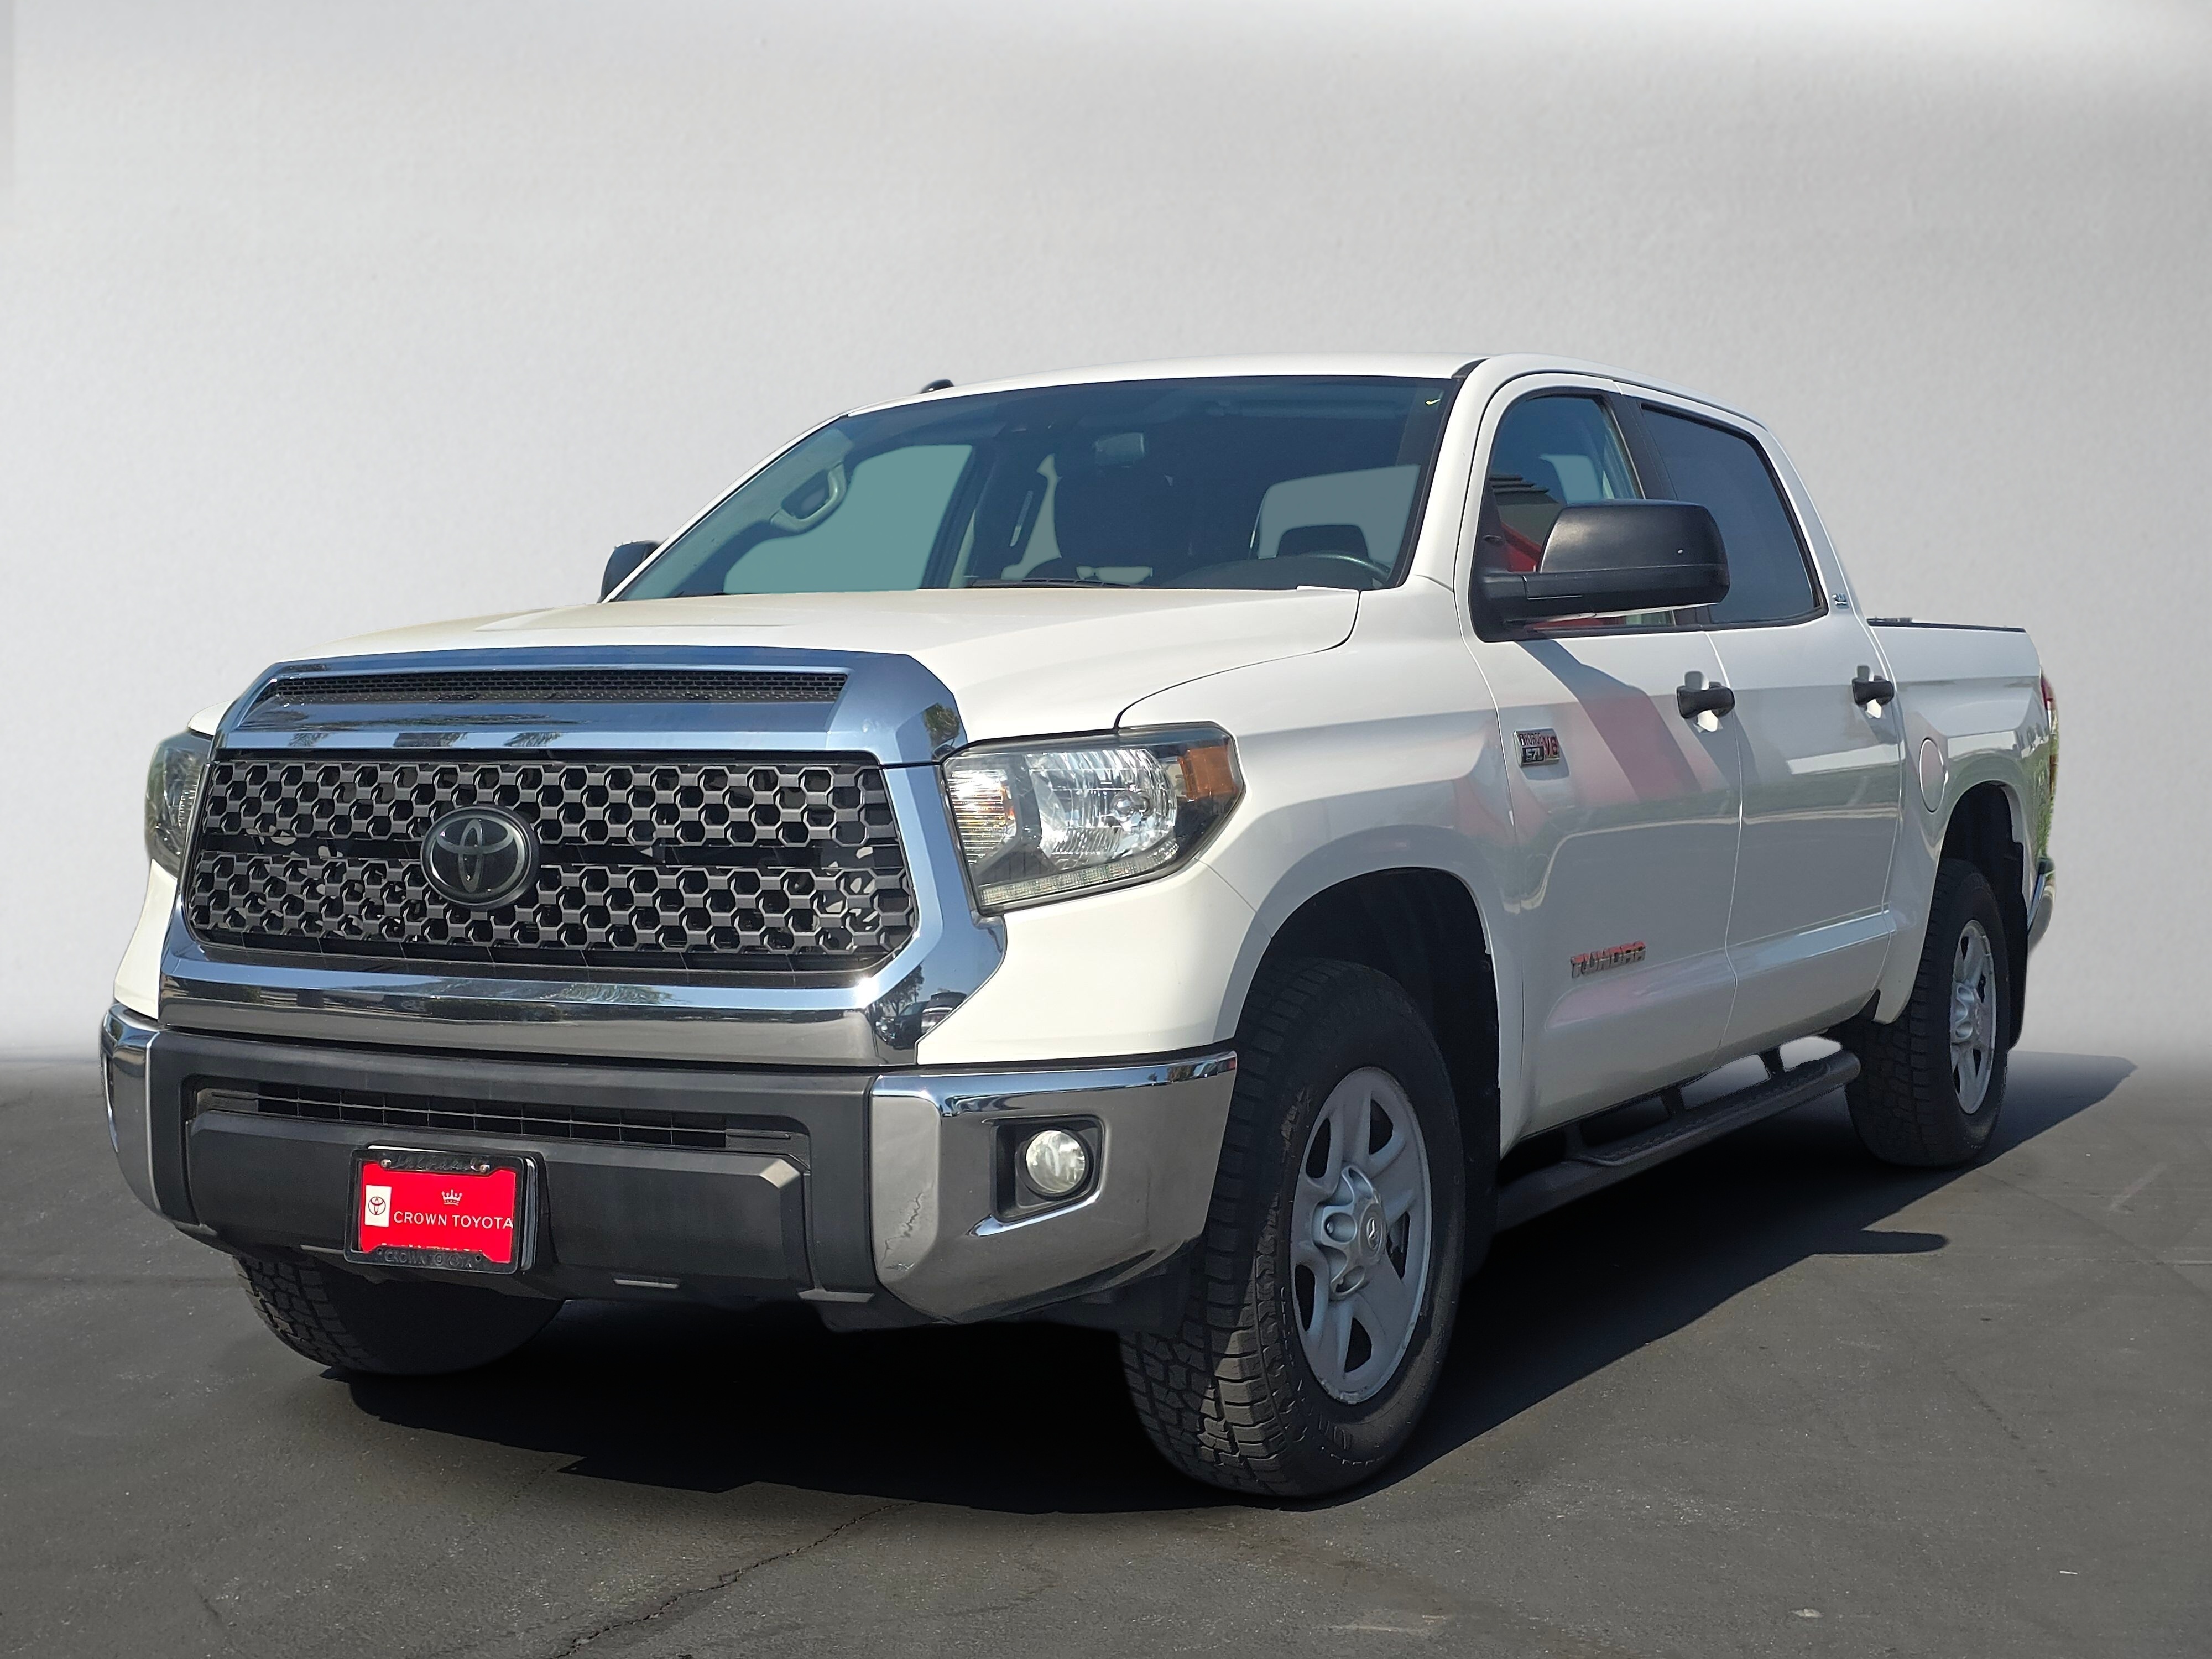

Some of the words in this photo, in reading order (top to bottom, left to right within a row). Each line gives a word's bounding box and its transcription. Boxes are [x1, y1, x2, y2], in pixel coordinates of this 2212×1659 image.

[1571, 941, 1646, 979] TUNDRA
[393, 1211, 447, 1227] CROWN
[452, 1214, 514, 1229] TOYOTA
